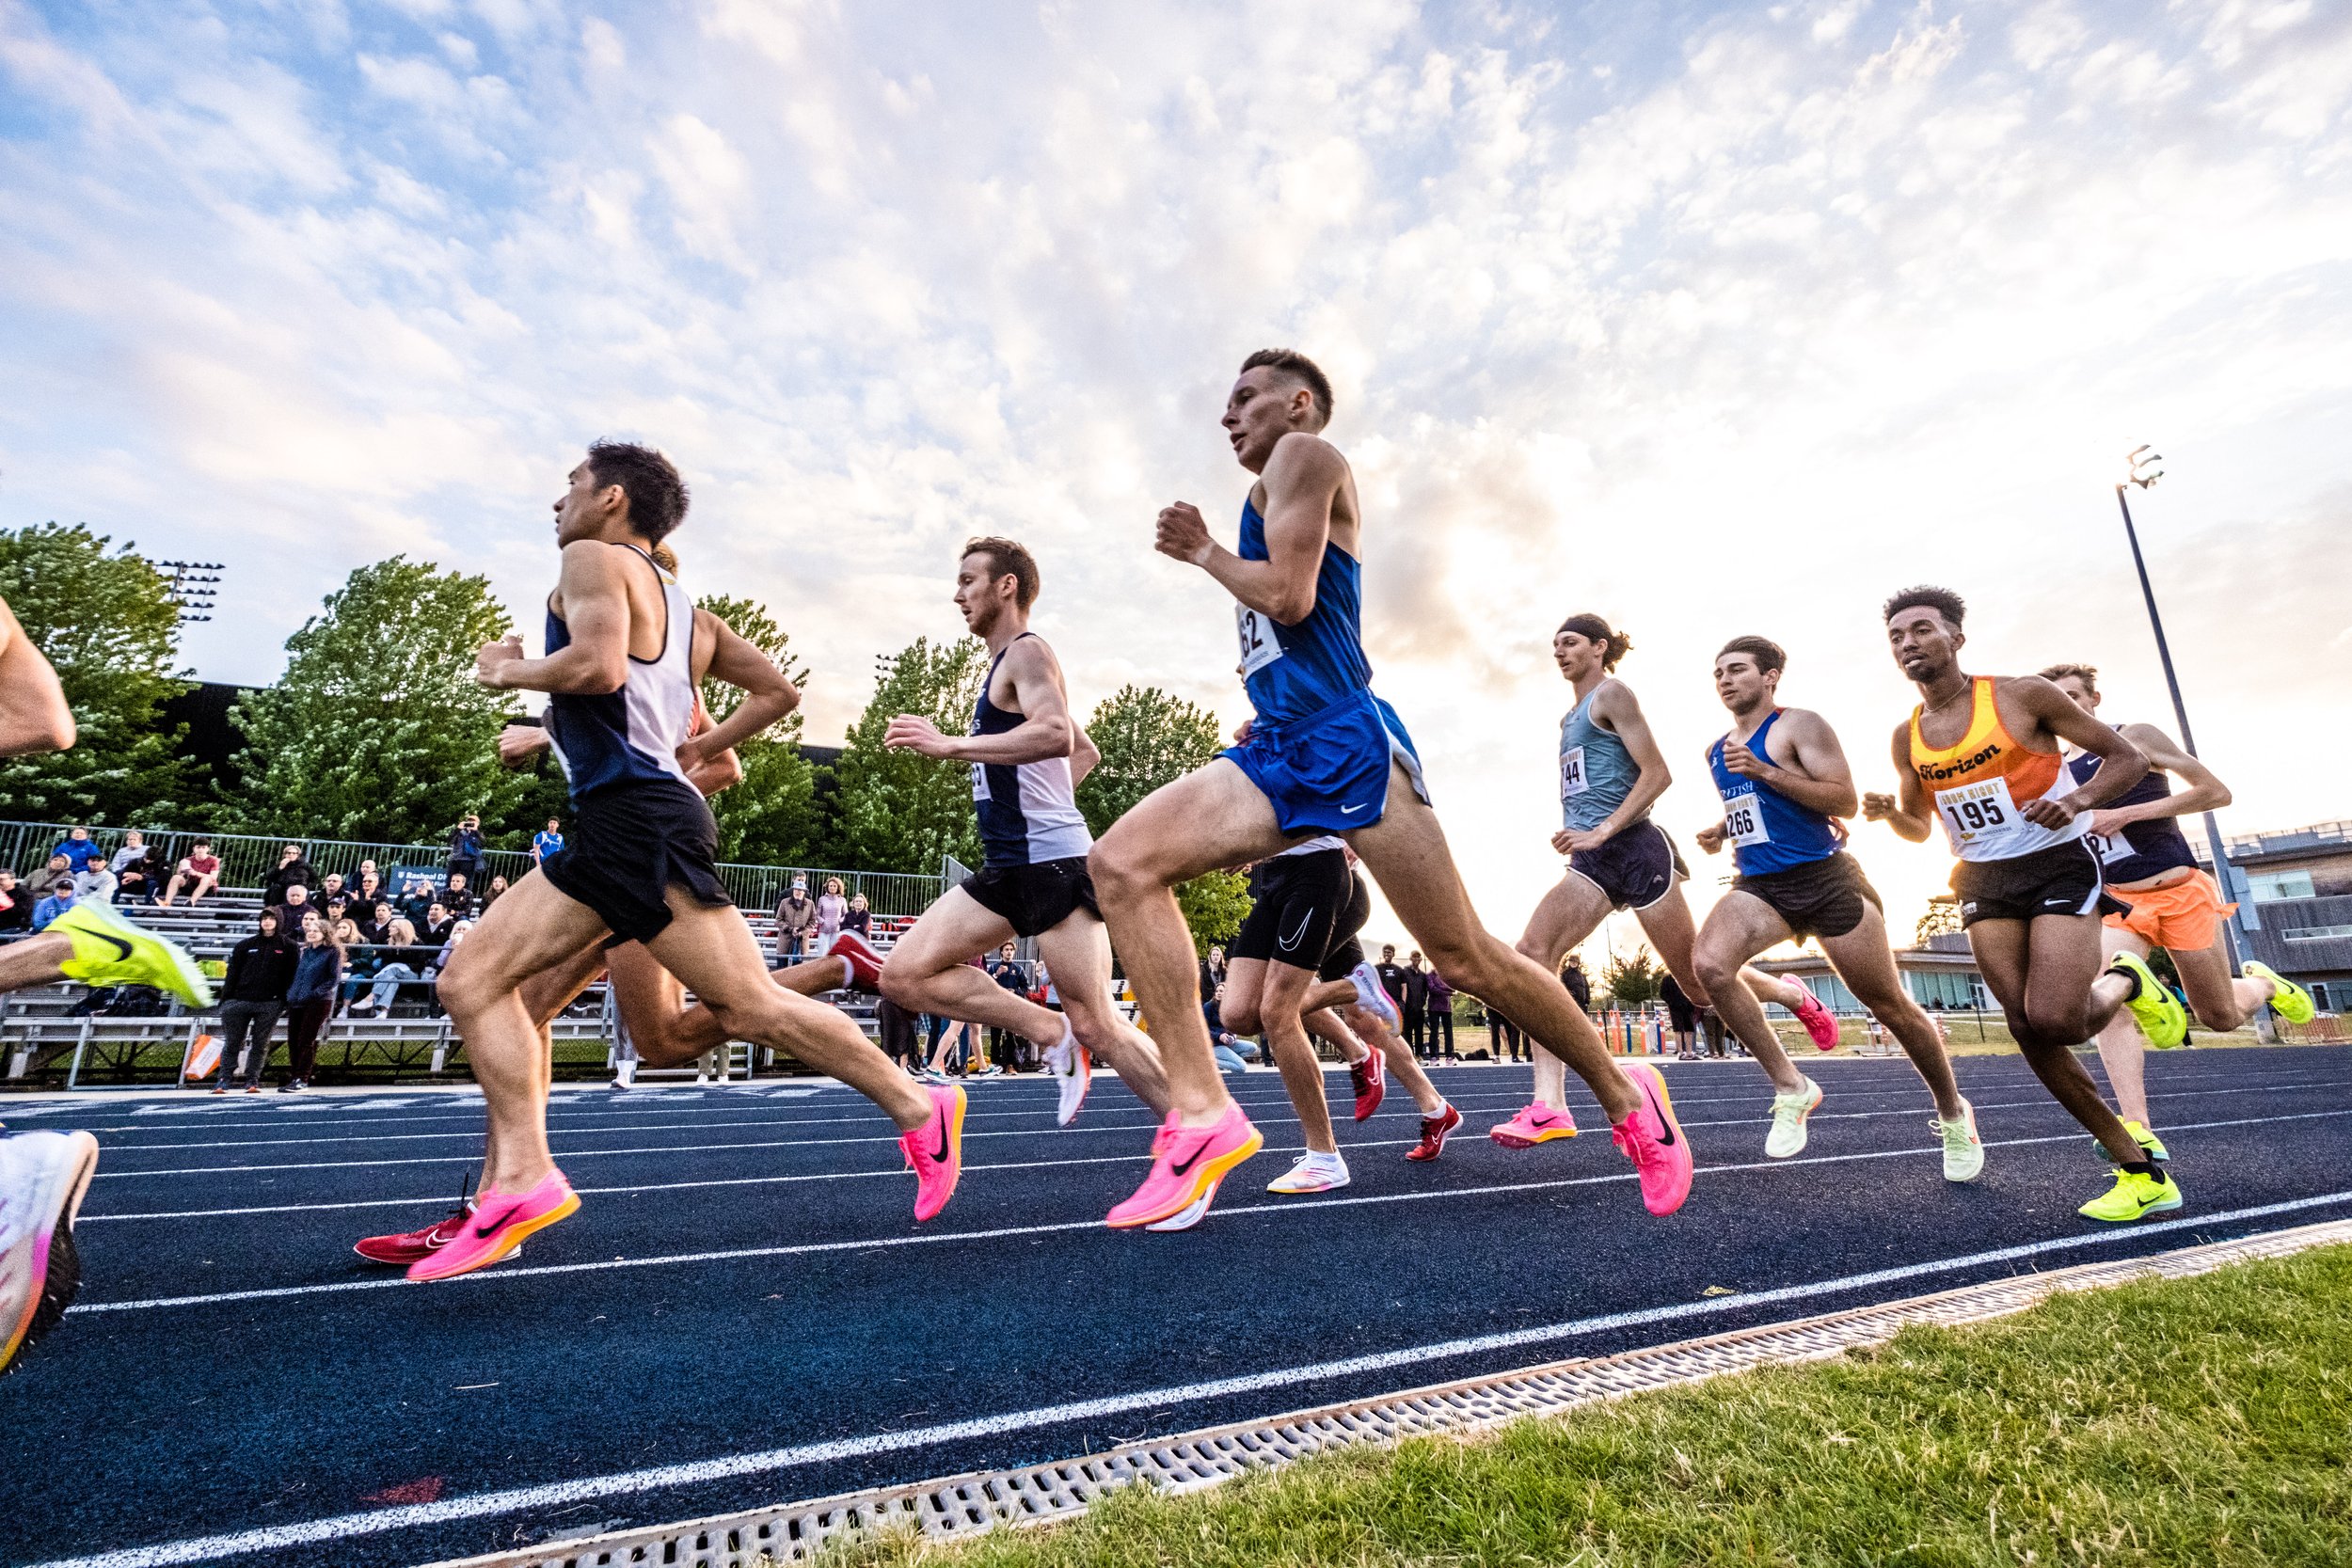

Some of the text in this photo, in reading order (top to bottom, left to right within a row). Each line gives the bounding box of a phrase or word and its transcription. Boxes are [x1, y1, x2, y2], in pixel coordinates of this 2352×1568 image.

[1919, 744, 2002, 782] Horizon
[1726, 809, 1755, 837] 266
[1947, 797, 2005, 832] 195
